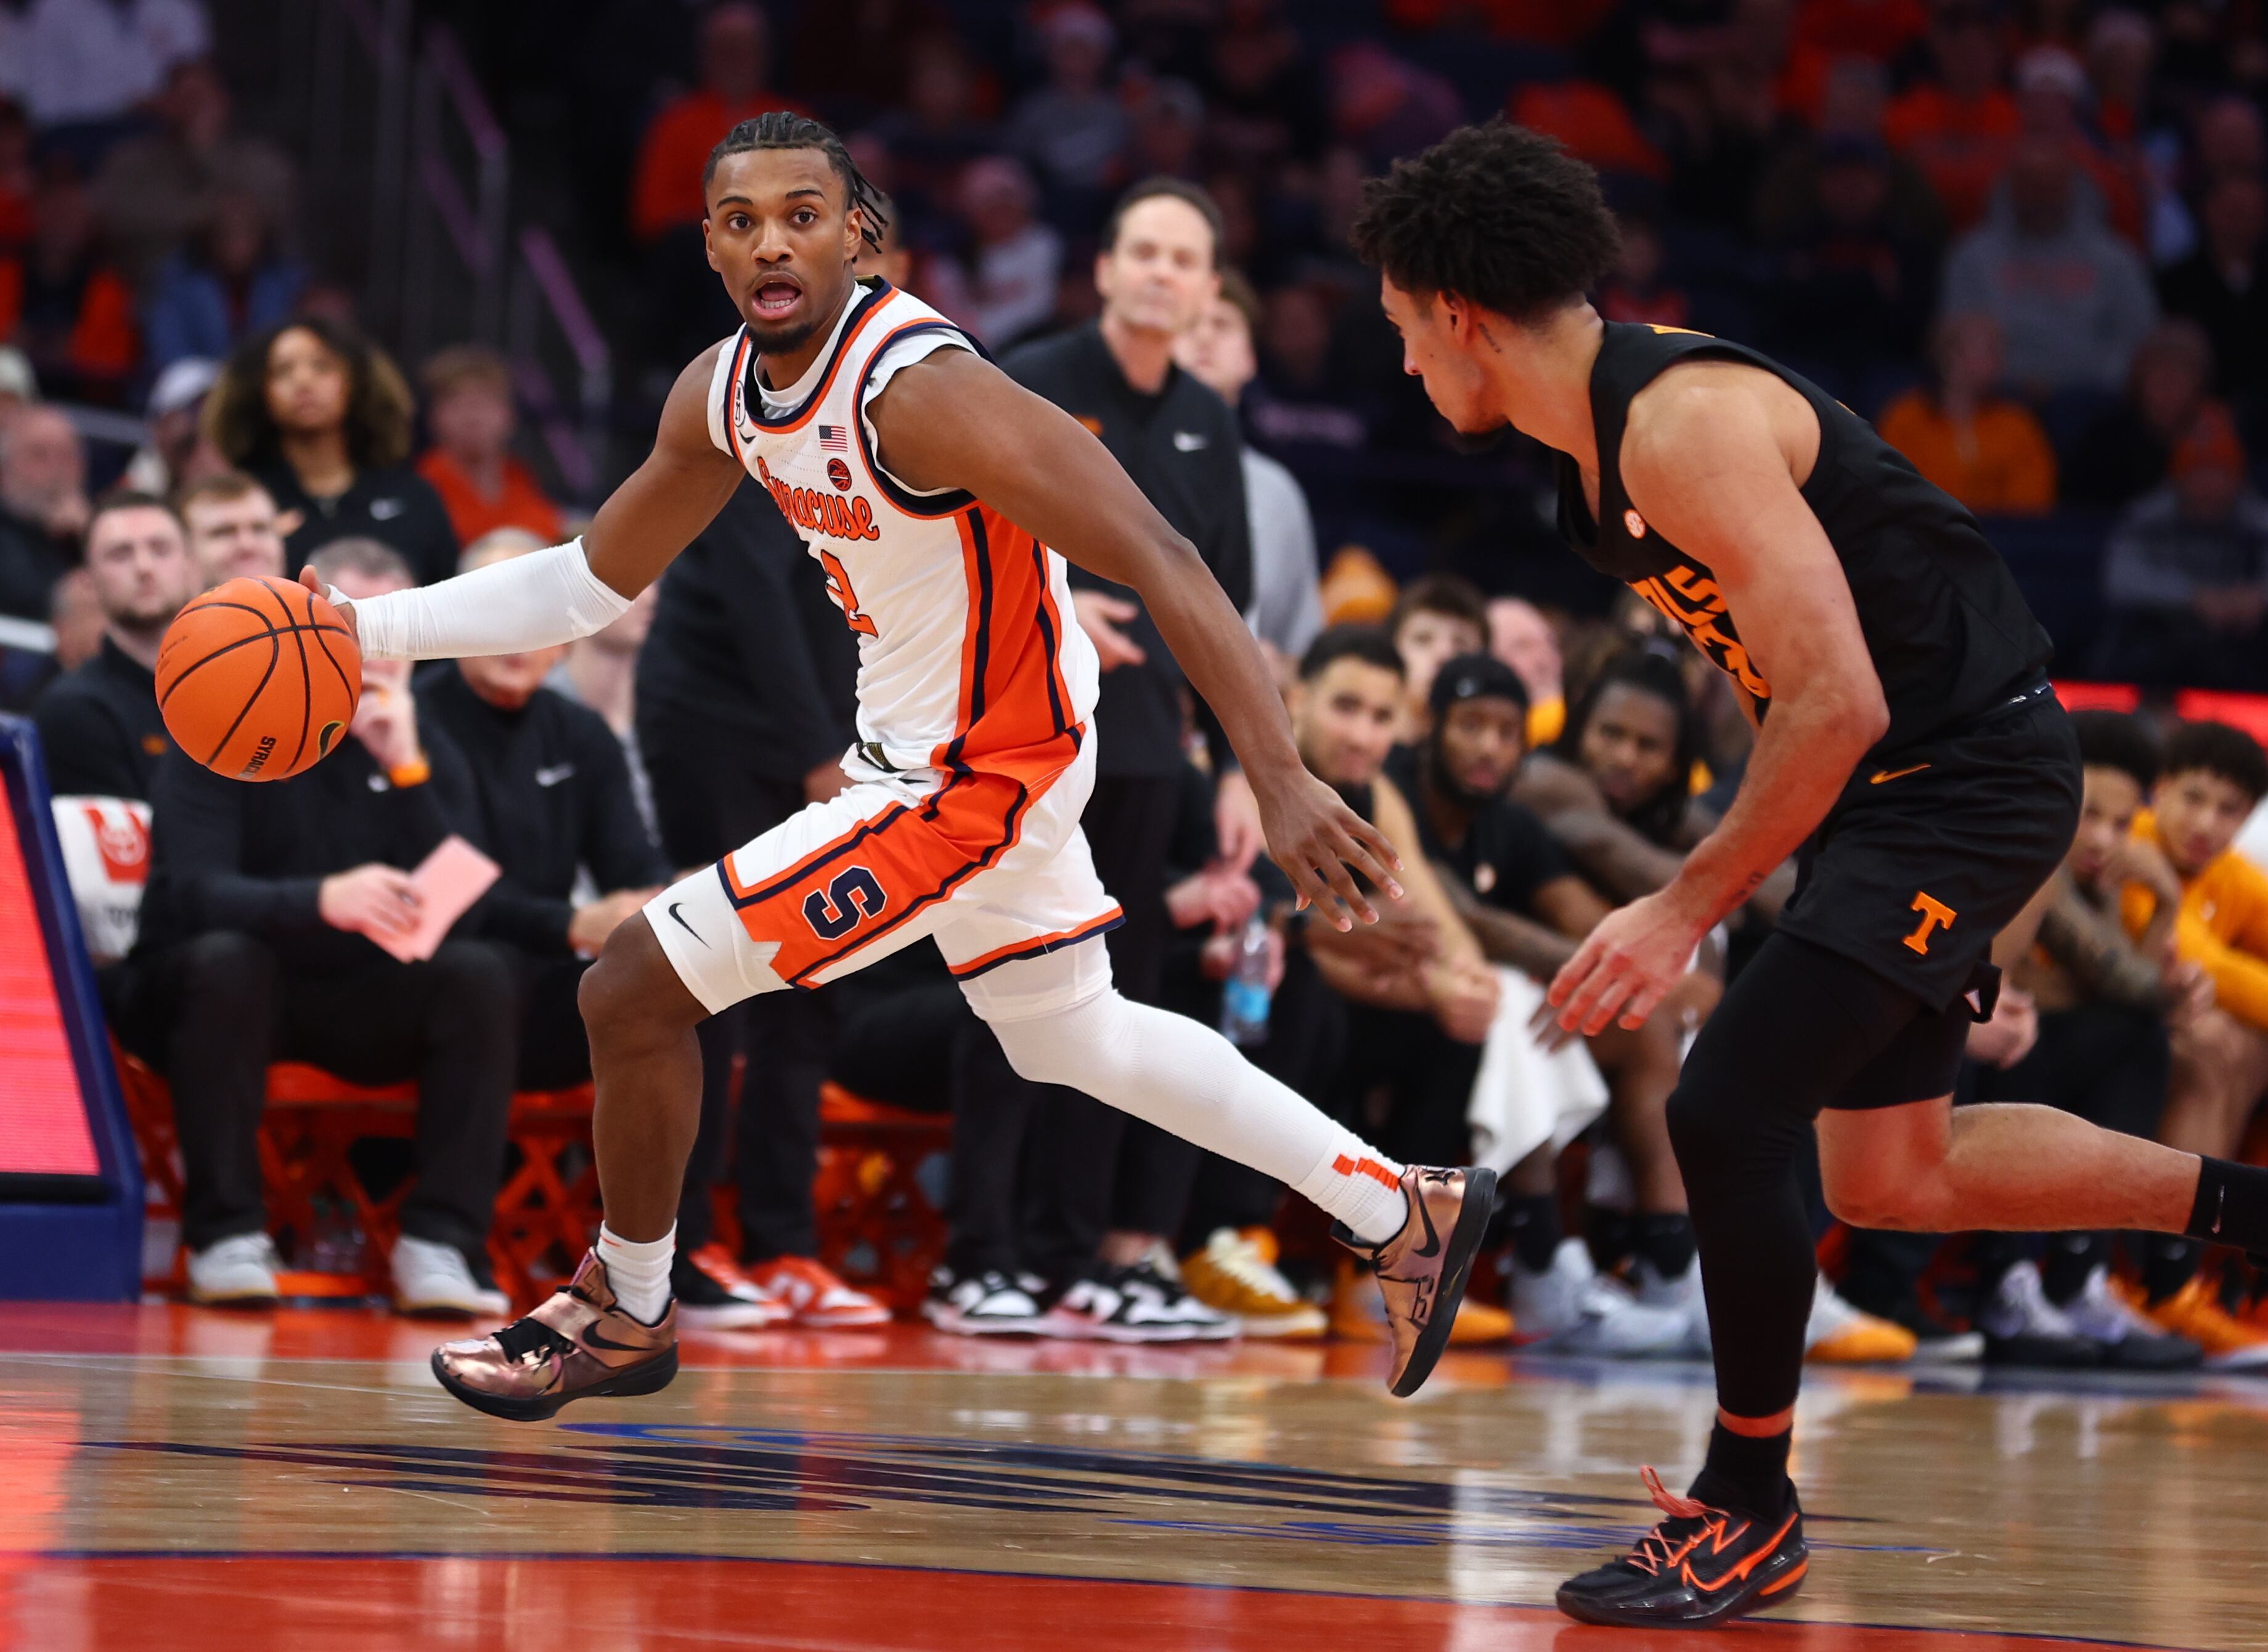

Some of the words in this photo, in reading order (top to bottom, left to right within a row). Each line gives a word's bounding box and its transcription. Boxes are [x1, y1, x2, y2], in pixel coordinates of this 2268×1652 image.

[757, 455, 880, 541] Syracuse
[820, 548, 879, 639] 2
[237, 735, 277, 780] SYRAC
[801, 865, 888, 941] S
[1902, 890, 1957, 956] T
